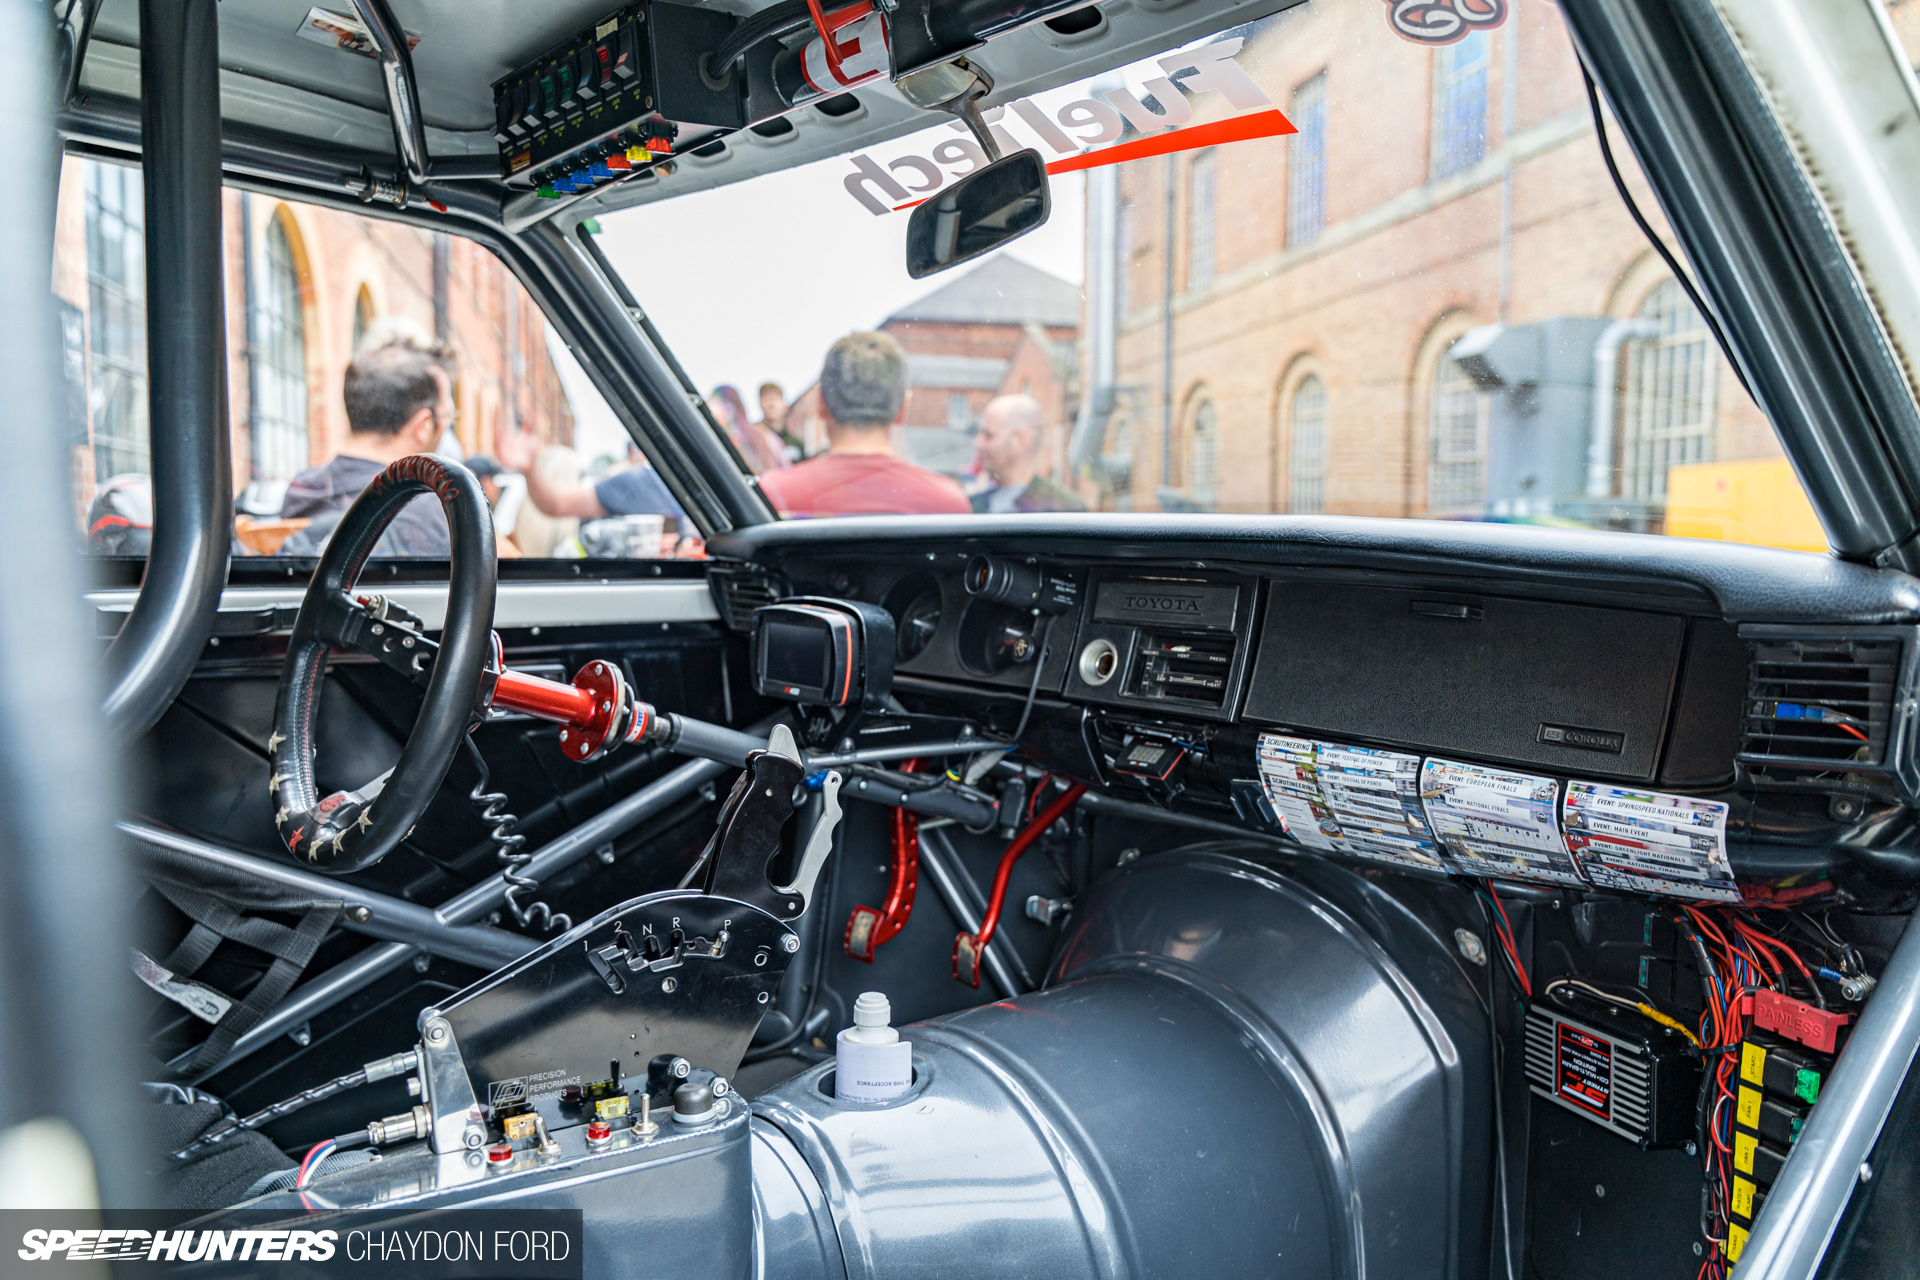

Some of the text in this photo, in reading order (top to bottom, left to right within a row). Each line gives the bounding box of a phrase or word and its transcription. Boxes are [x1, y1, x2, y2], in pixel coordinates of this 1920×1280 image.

[1125, 597, 1198, 611] TOYOTA
[1266, 738, 1310, 751] SCRUTINEERING
[1566, 732, 1617, 748] COROLLA
[1272, 778, 1315, 792] SCRUTINEERING
[1449, 774, 1518, 793] EVENT: EUROPEAN FINALS
[1466, 800, 1490, 810] NATIONAL
[1492, 806, 1510, 814] FINALS
[1597, 799, 1690, 819] EVENT: SPRINGSPEED NATIONALS
[1594, 822, 1648, 837] EVENT: MAIN EVENT
[1514, 850, 1534, 858] FINALS
[1594, 842, 1686, 863] EVENT: GREENLIGHT NATIONALS
[1626, 860, 1657, 870] NATIONAL
[1658, 866, 1680, 874] FINALS
[614, 920, 622, 933] 2
[672, 917, 680, 928] R
[724, 920, 731, 930] P
[642, 924, 652, 936] N
[583, 940, 588, 952] 1
[1757, 1004, 1822, 1038] PAINLESS
[1573, 1058, 1596, 1072] IGNITION
[529, 1068, 566, 1082] PRECISION
[1566, 1070, 1610, 1094] STREET FIRE
[529, 1076, 581, 1092] PERFORMANCE
[529, 1088, 568, 1101] PRODUCTS
